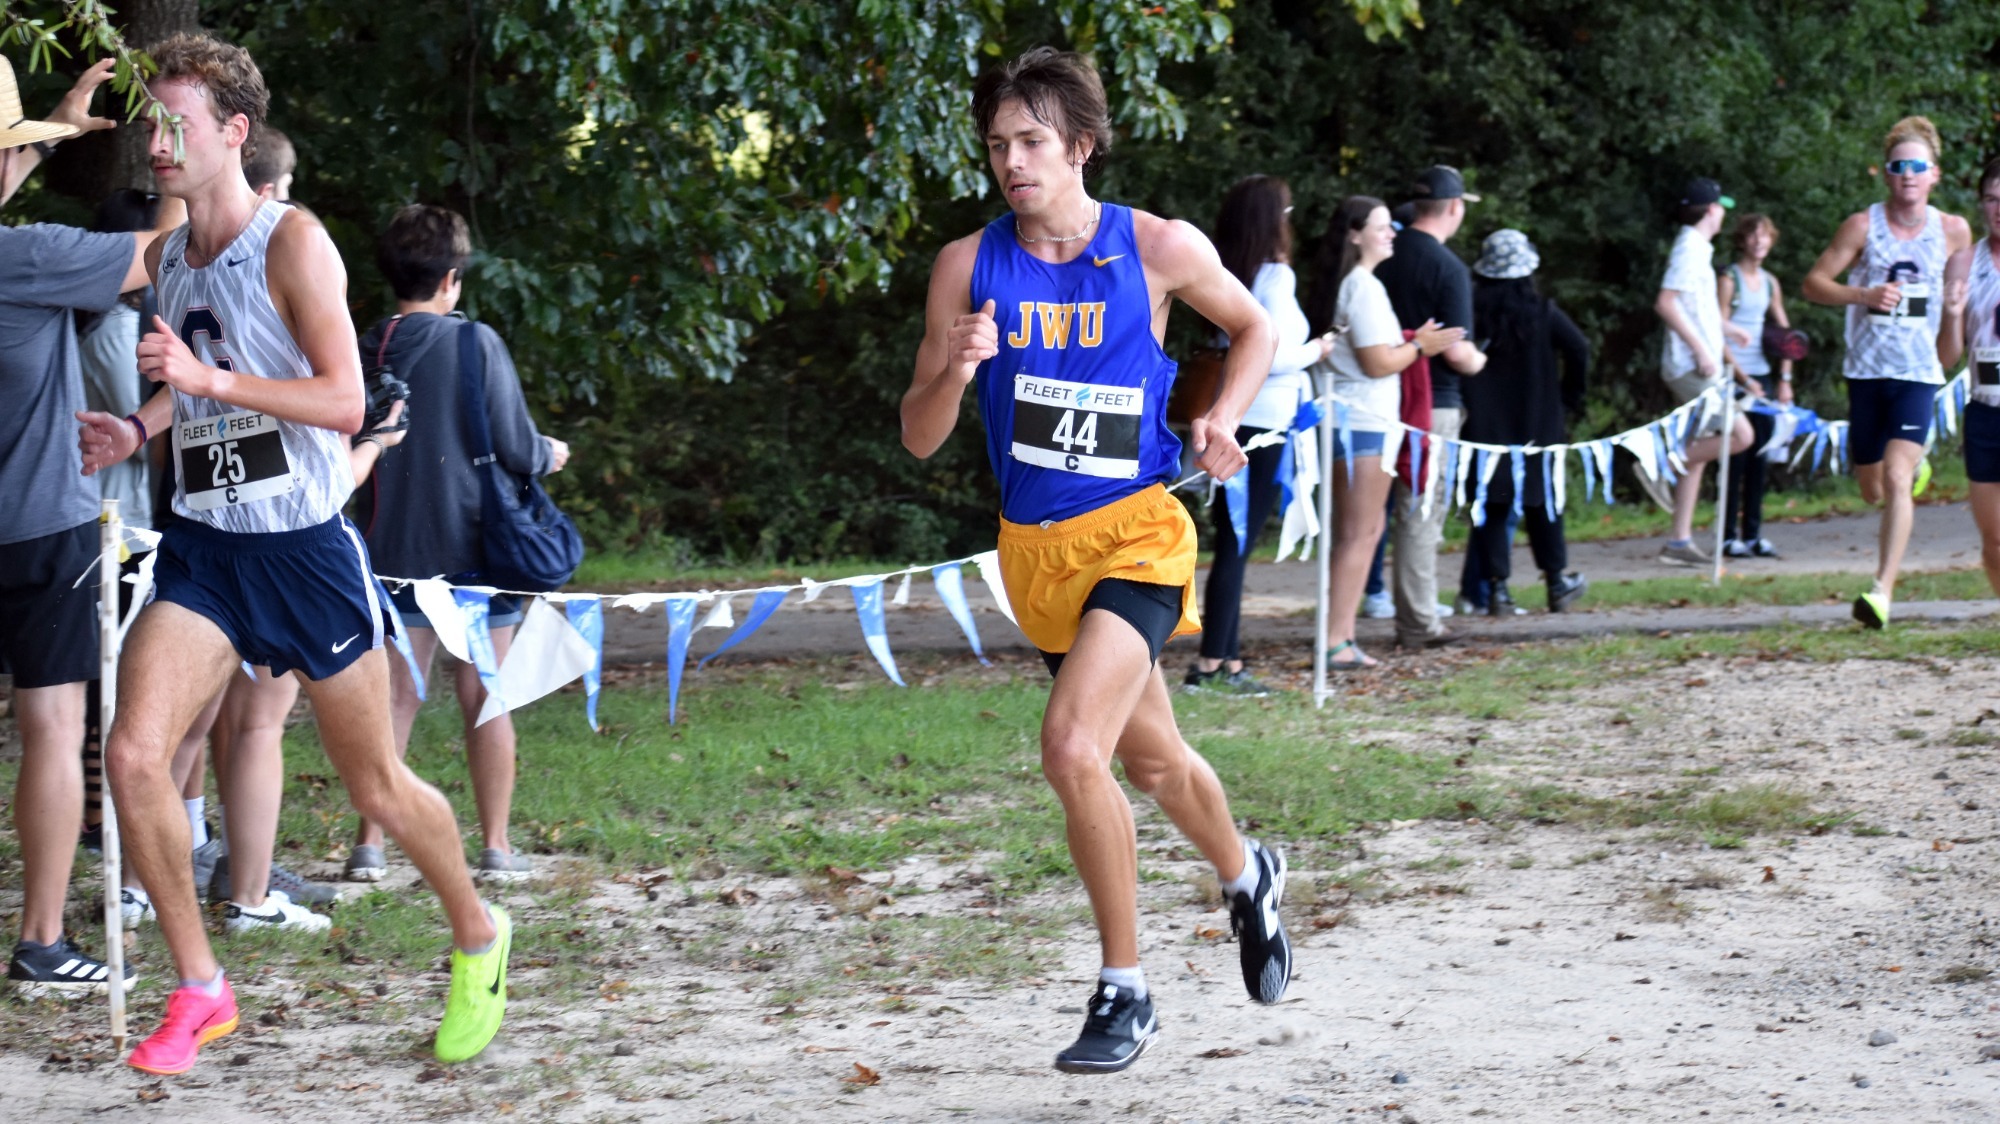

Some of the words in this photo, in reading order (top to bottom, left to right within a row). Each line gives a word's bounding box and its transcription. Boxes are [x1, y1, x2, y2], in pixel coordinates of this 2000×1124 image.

[1008, 302, 1106, 349] JWU
[1024, 382, 1072, 400] FLEET
[1094, 392, 1134, 407] FEET
[183, 423, 214, 441] FLEET
[230, 413, 264, 432] FEET
[1052, 409, 1098, 454] 44
[208, 440, 247, 487] 25
[1065, 455, 1080, 471] C
[225, 486, 239, 504] C
